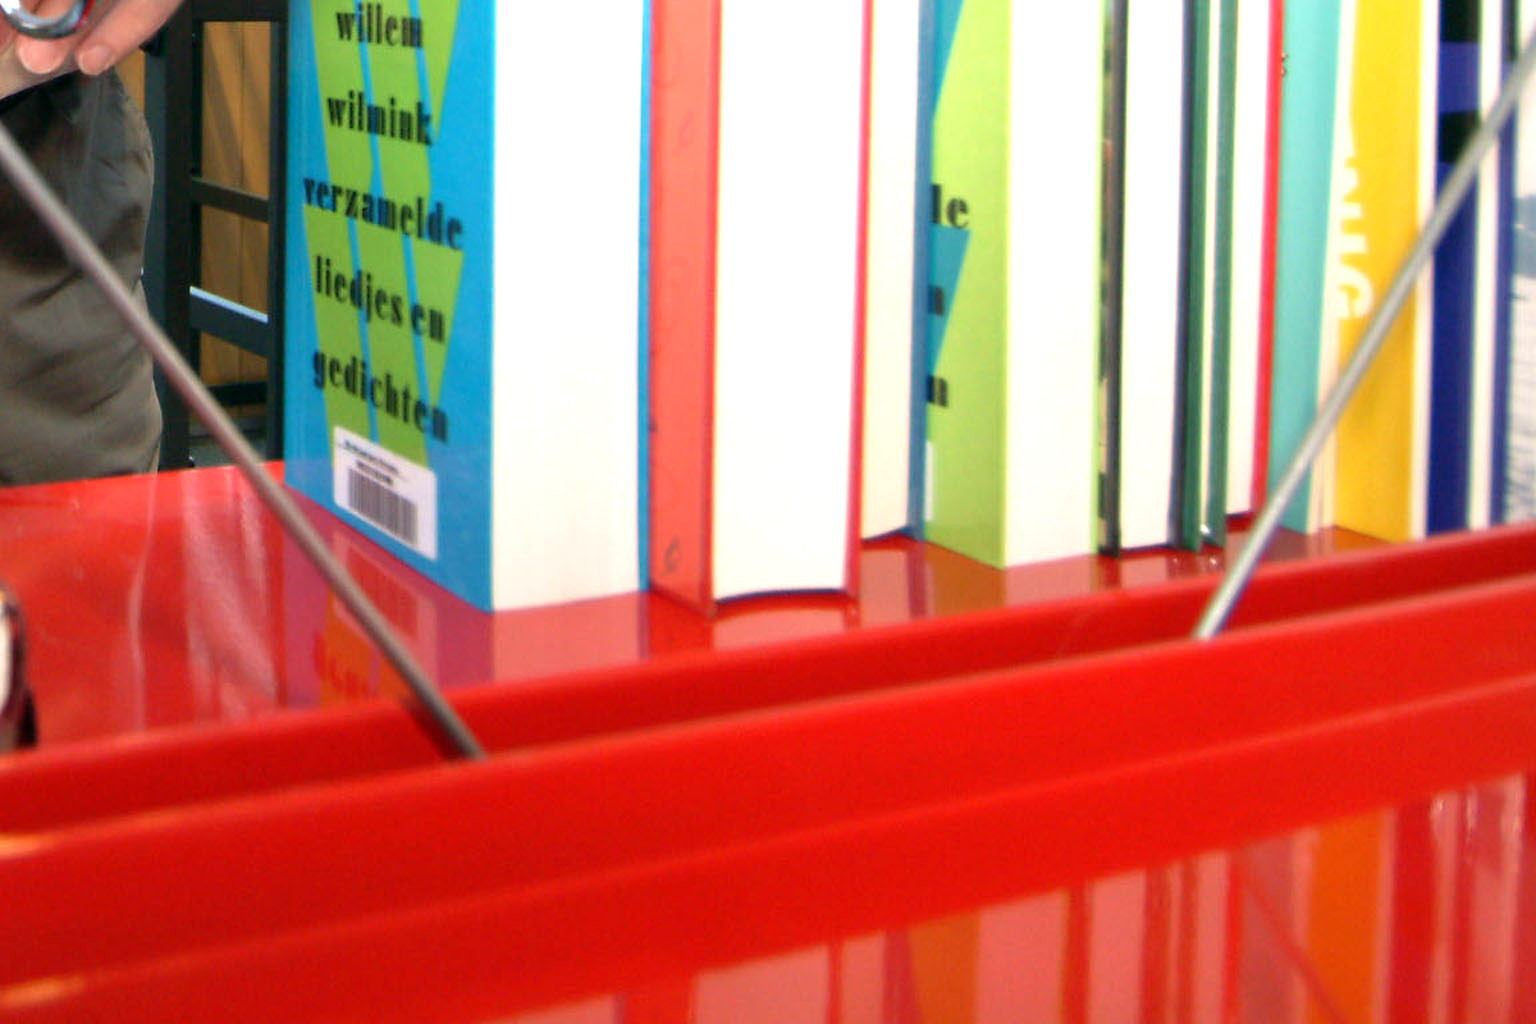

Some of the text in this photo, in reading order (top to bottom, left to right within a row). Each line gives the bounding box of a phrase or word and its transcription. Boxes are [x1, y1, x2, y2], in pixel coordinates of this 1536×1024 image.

[336, 2, 424, 49] willem
[326, 89, 433, 147] wilmink
[303, 177, 464, 251] verzamelde
[315, 255, 447, 344] liedjes en
[312, 350, 449, 444] gedichten
